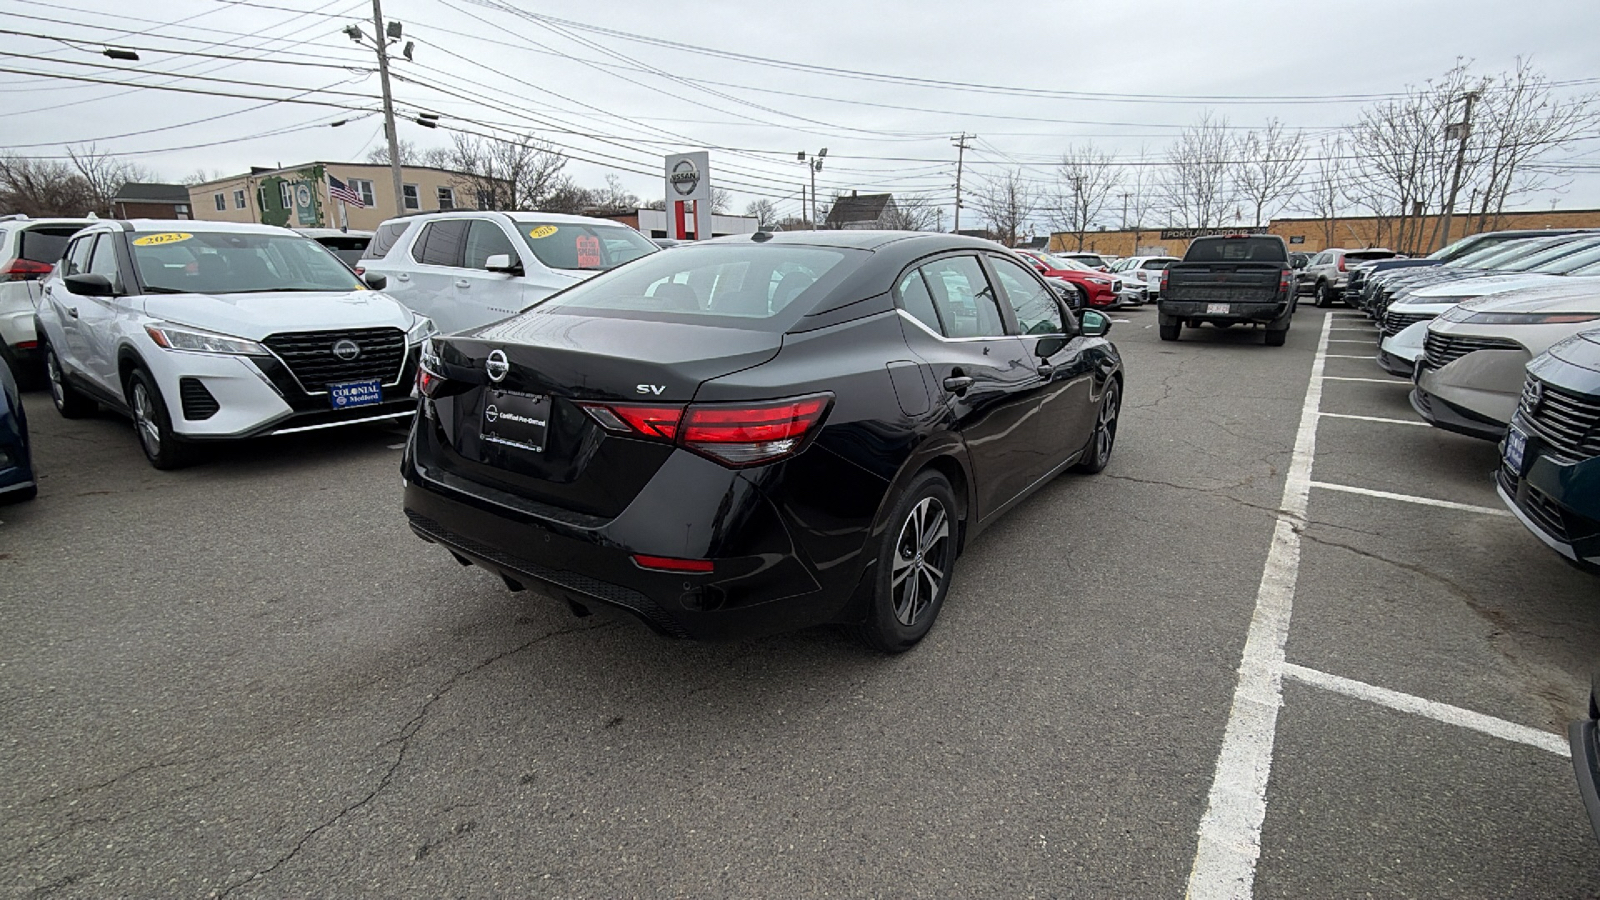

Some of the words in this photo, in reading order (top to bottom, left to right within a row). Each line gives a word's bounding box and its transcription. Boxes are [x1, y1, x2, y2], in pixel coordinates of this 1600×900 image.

[146, 233, 183, 244] 2023
[1167, 229, 1213, 239] PORTLAND
[332, 385, 379, 397] COLONIAL
[636, 384, 667, 395] SV
[349, 393, 379, 403] Medford
[499, 411, 519, 421] Certified
